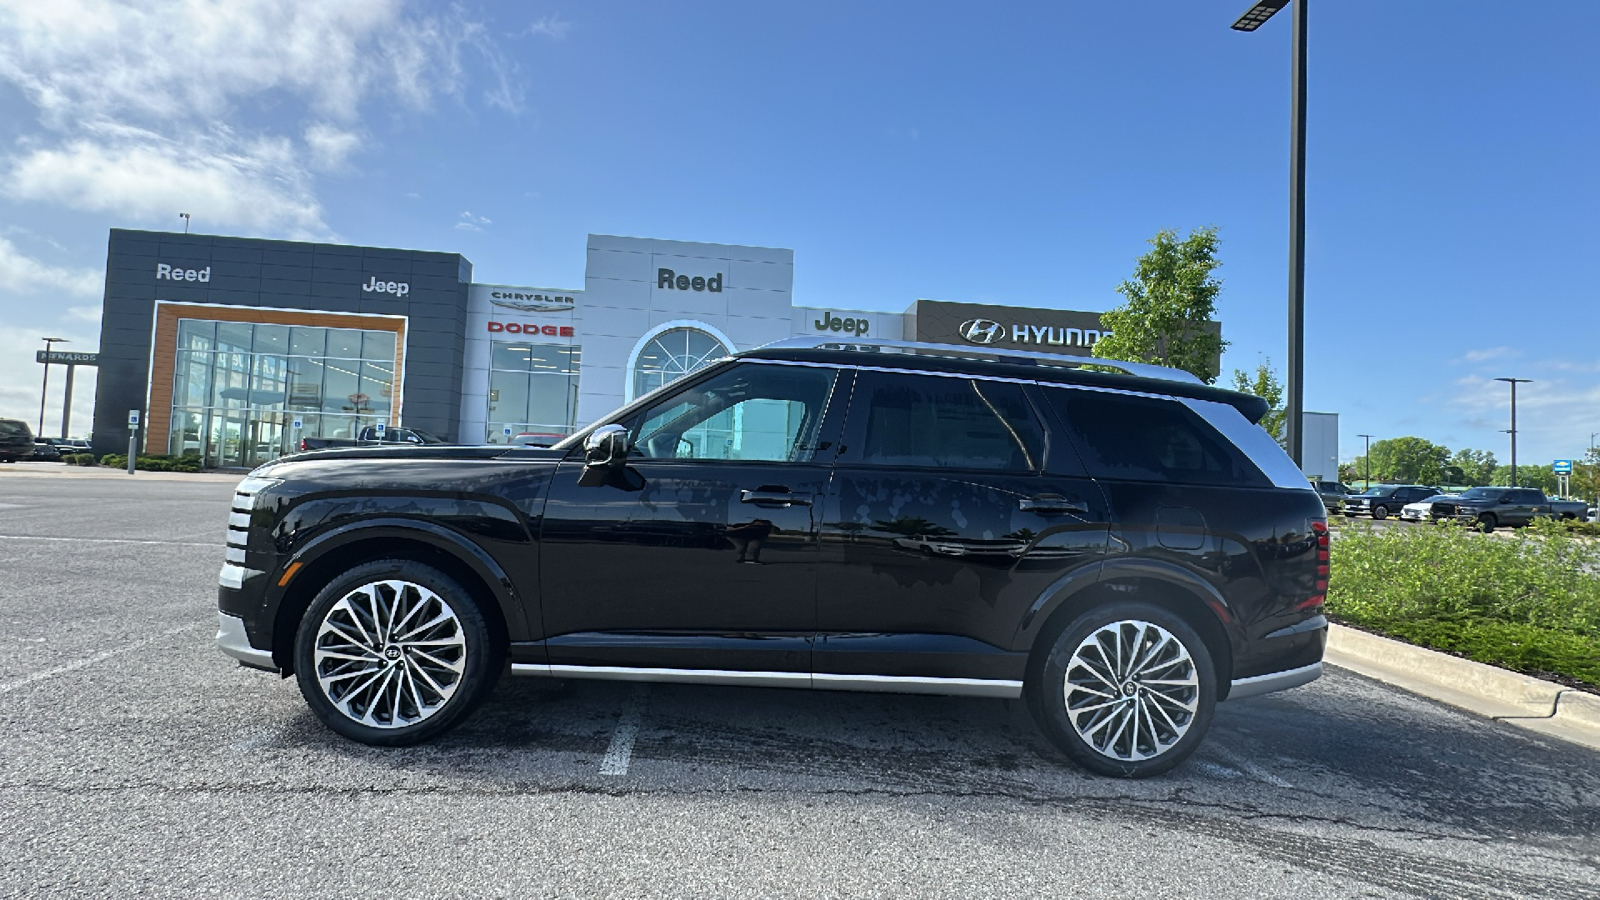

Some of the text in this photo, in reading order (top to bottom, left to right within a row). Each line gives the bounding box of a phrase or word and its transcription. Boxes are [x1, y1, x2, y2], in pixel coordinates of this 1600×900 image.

[157, 263, 211, 283] Reed
[657, 267, 723, 293] Reed
[362, 276, 409, 297] Jeep
[491, 292, 574, 304] CHRYSLER
[487, 321, 575, 337] DODGE
[814, 311, 869, 337] Jeep
